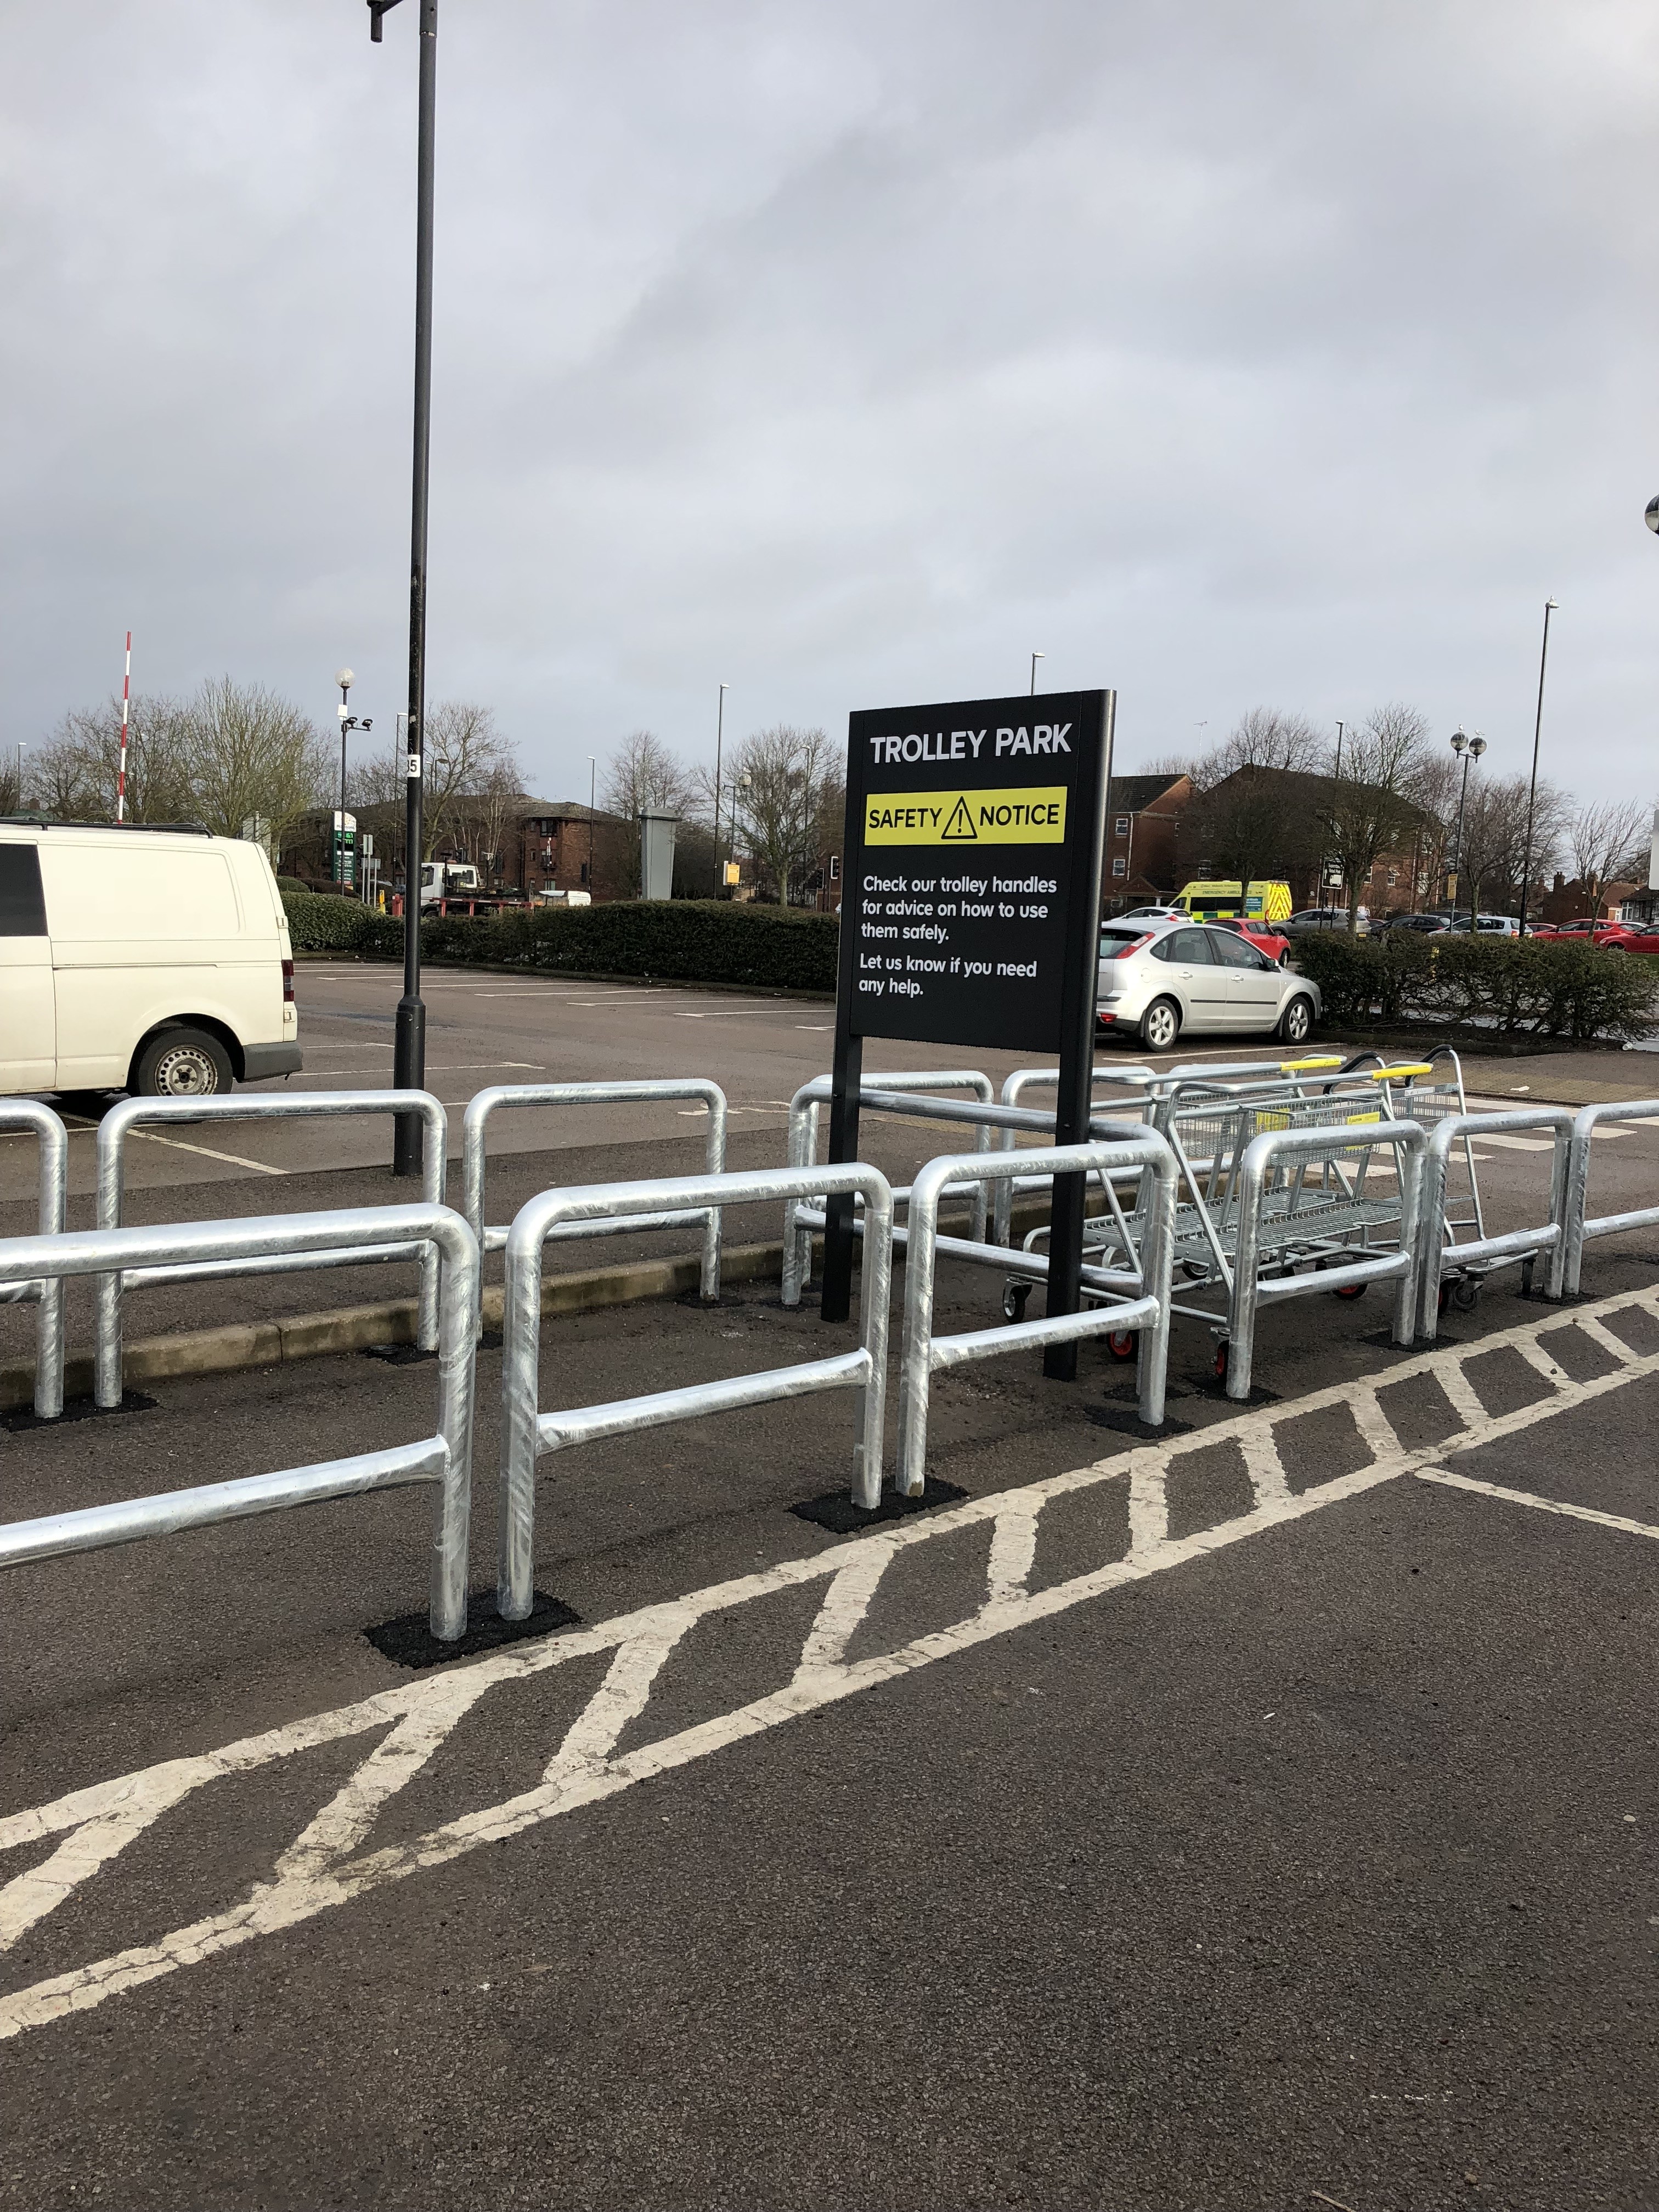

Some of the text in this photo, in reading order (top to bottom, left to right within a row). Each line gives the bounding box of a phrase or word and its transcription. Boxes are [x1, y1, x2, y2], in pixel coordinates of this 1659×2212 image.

[871, 724, 1073, 763] TROLLEY PARK
[869, 804, 1059, 828] SAFETY NOTICE
[864, 876, 1057, 896] Check our trolley handles
[862, 899, 1048, 918] for advice on how to use
[861, 922, 949, 944] them safely.
[860, 953, 1037, 978] Let us know if you need
[859, 979, 923, 998] any help.
